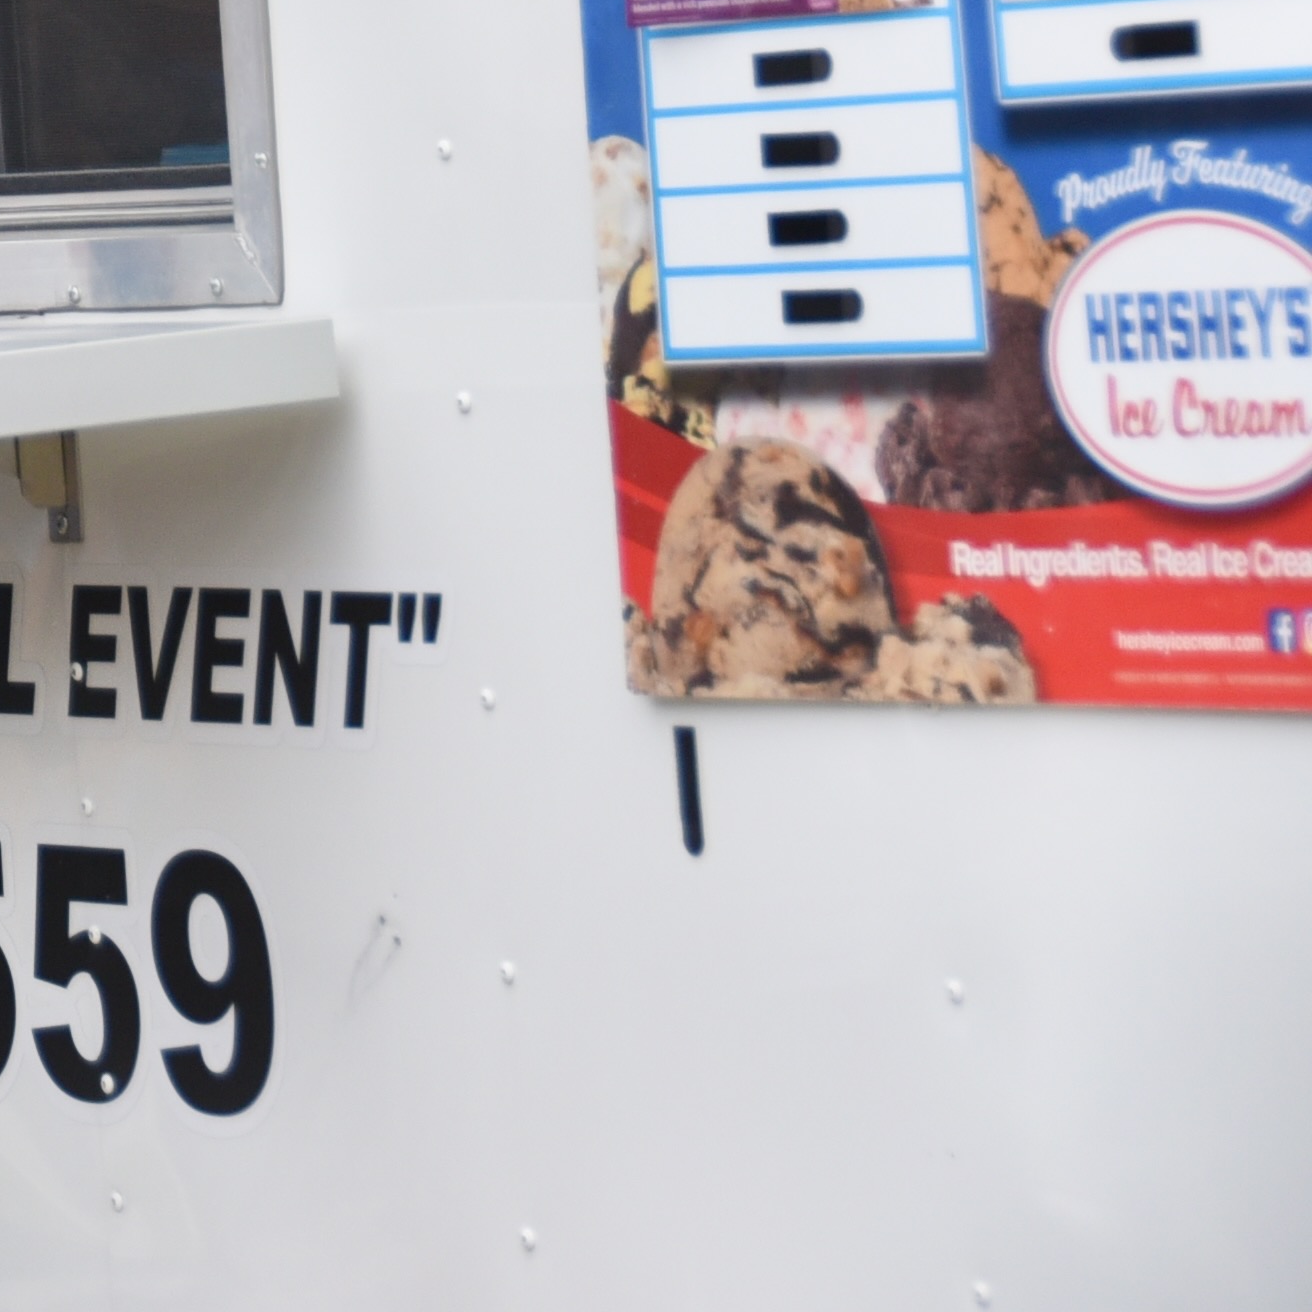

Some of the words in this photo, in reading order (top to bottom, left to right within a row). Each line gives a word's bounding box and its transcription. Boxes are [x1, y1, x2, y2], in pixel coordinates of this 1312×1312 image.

[1057, 145, 1166, 224] Proudly
[1169, 139, 1312, 225] Featuring
[1084, 288, 1312, 364] HERSHEY'S
[1107, 374, 1161, 439] Ice
[1172, 377, 1312, 439] Cream
[951, 543, 1001, 576] Real
[1150, 543, 1205, 576] Real
[68, 584, 443, 730] EVENT"
